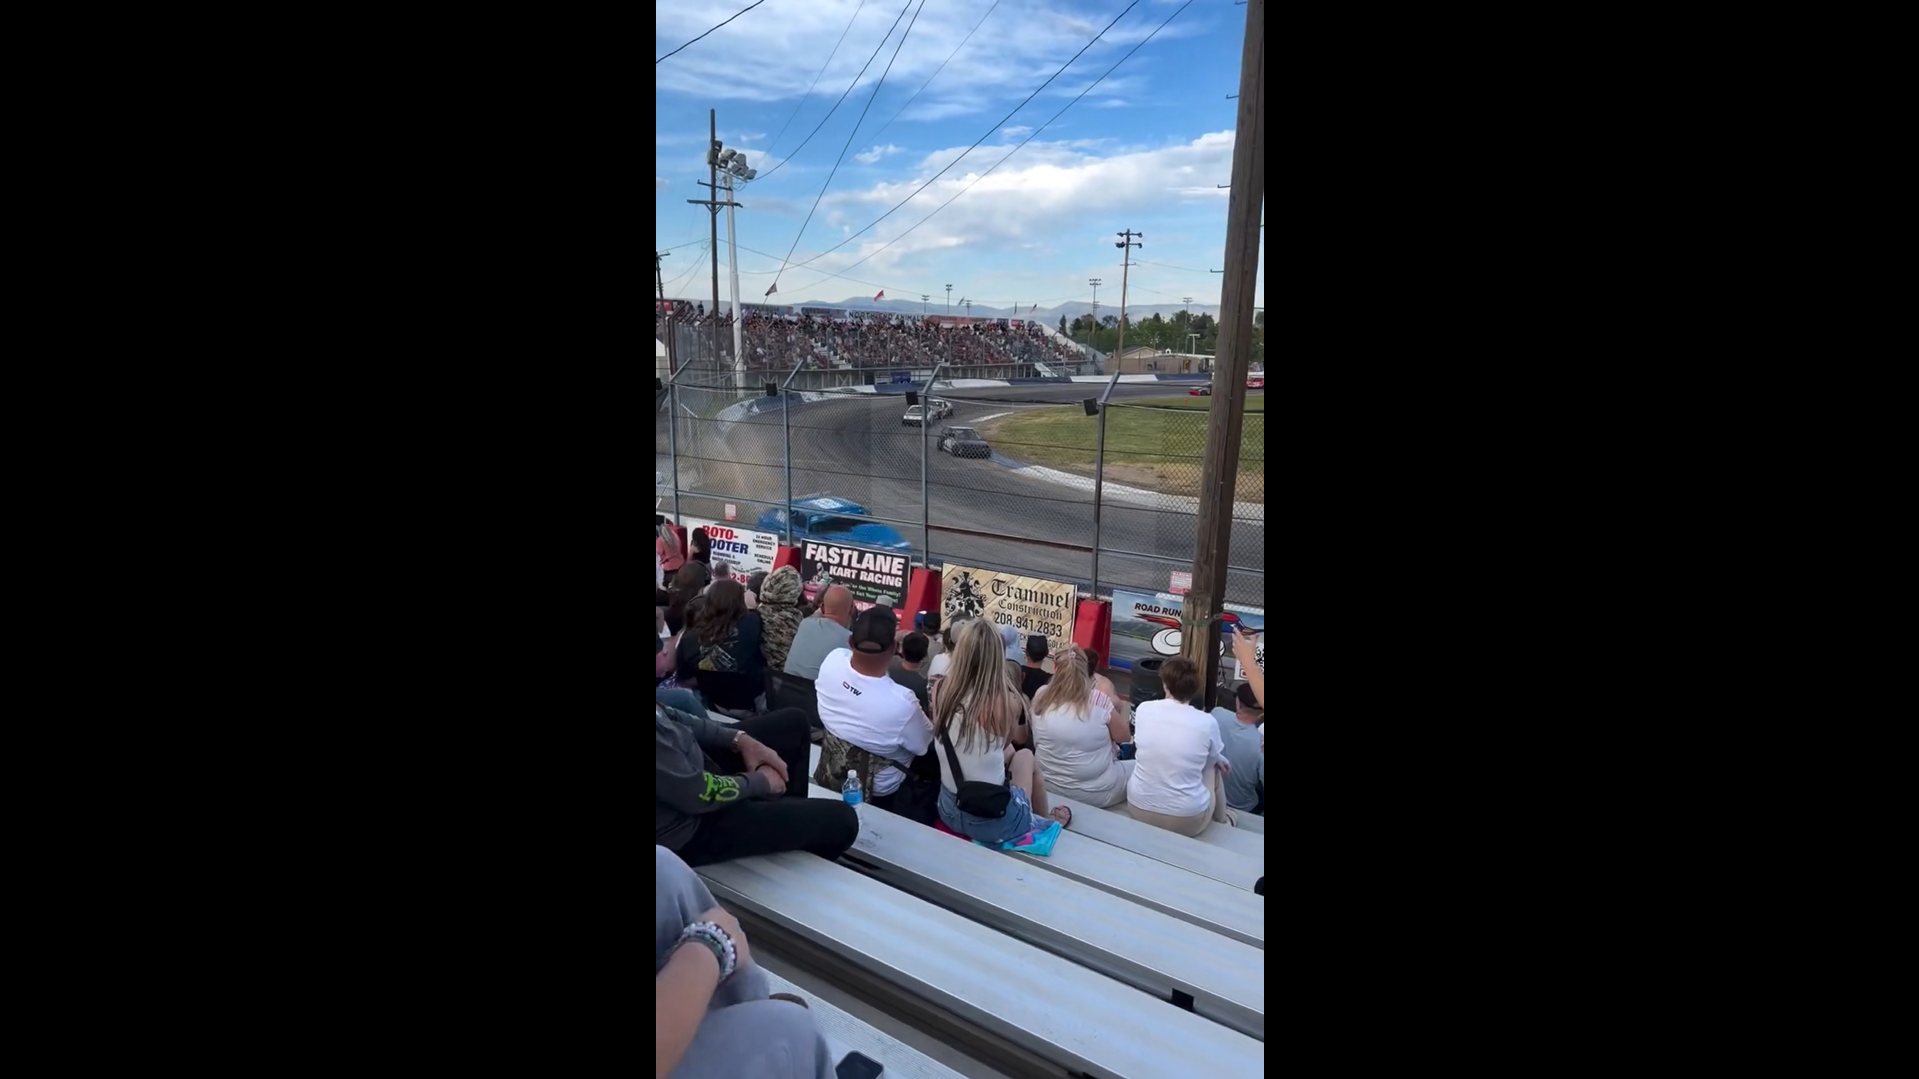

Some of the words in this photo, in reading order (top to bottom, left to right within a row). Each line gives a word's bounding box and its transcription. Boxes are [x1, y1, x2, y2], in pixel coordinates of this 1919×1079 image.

[848, 311, 875, 320] NORTH
[702, 525, 738, 540] ROTO-
[709, 538, 749, 554] OOTER
[805, 543, 905, 576] FASTLANE
[829, 565, 858, 579] KART
[860, 571, 902, 588] RACING
[991, 578, 1070, 609] Trammel
[998, 599, 1062, 620] Construction
[1134, 602, 1161, 613] ROAD
[1161, 607, 1183, 619] RUN
[994, 611, 1062, 637] 208.941.2833
